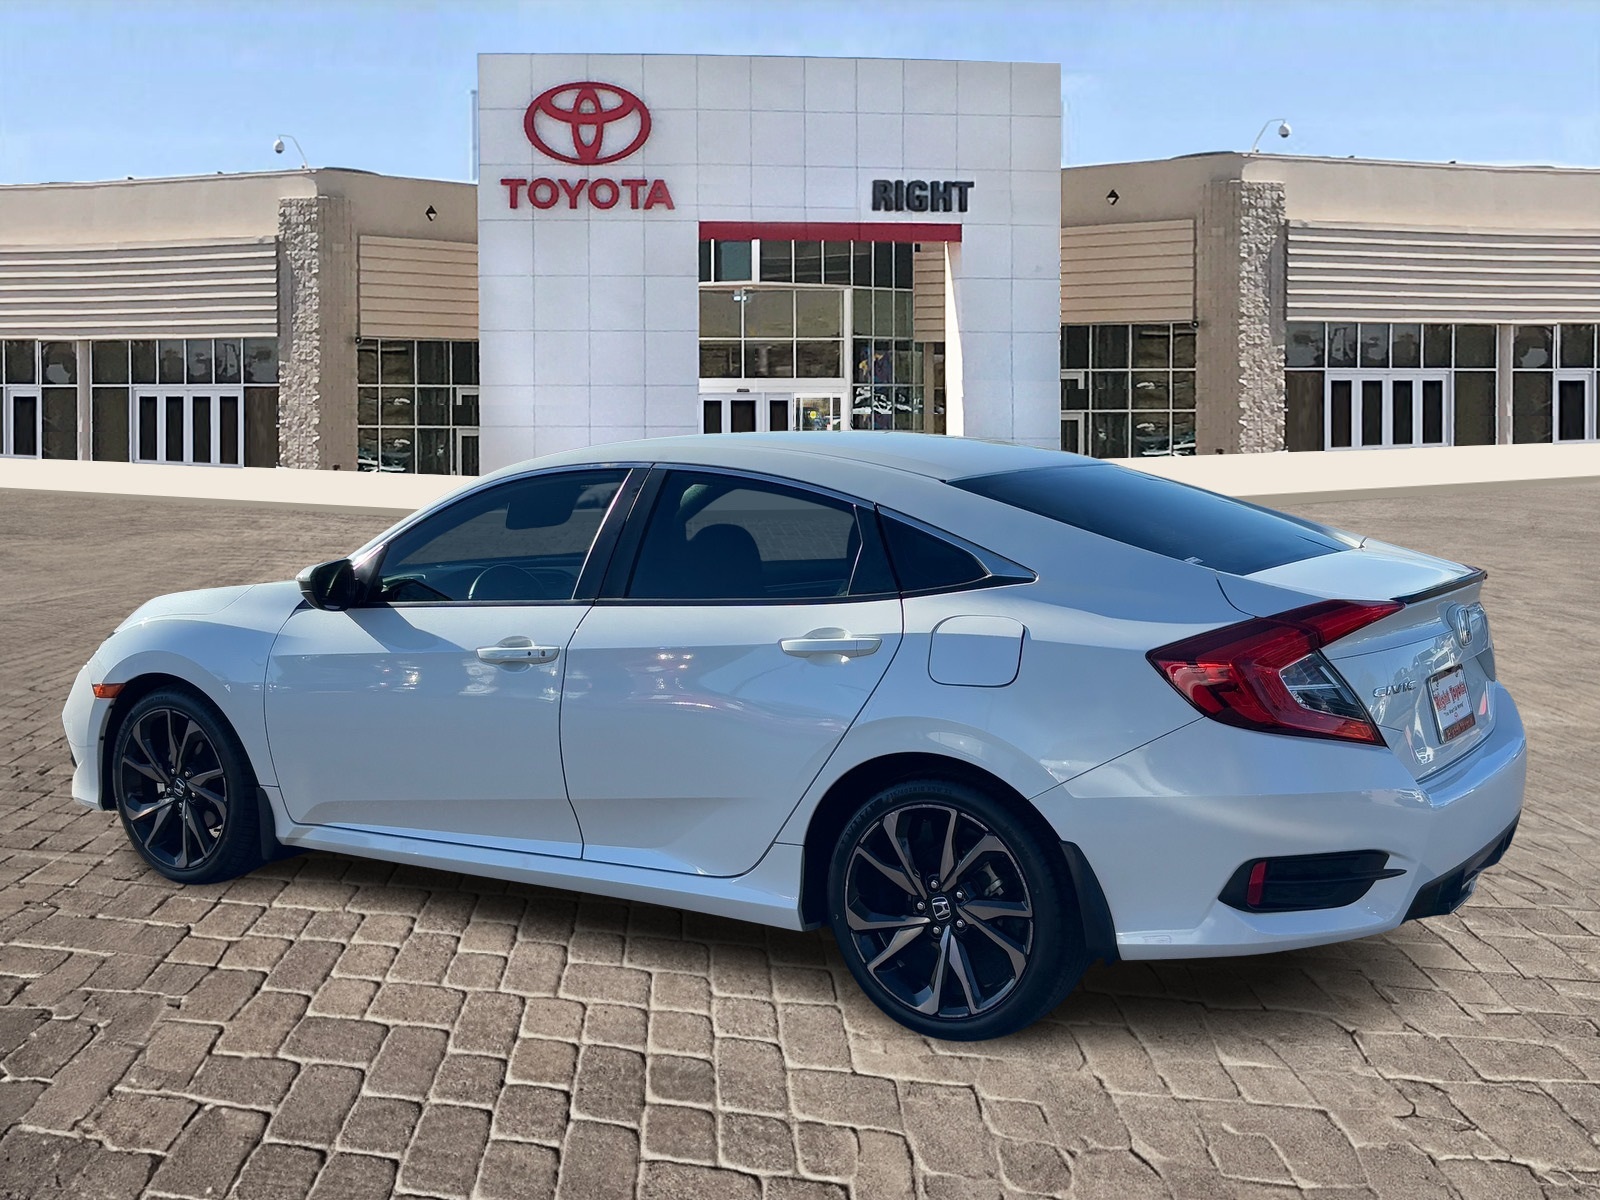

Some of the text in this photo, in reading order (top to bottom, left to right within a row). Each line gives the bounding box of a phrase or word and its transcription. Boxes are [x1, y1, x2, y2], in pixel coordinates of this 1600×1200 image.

[500, 178, 675, 210] TOYOTA
[872, 179, 975, 212] RIGHT
[1373, 680, 1417, 698] CIVIC
